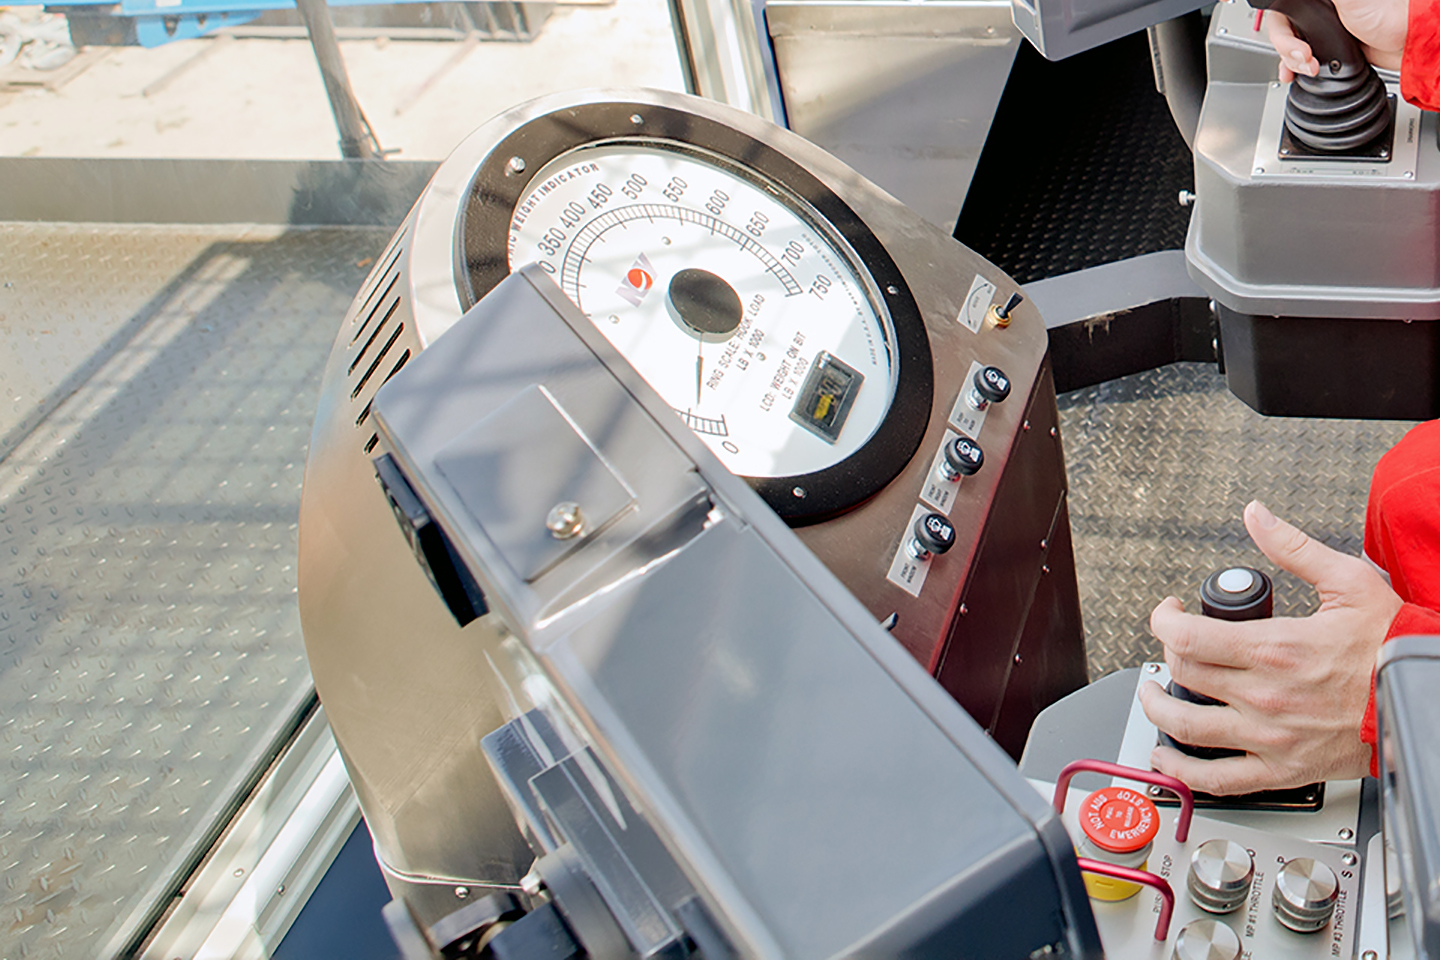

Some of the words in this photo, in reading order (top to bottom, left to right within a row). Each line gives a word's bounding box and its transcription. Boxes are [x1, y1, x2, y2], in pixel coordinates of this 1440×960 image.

[510, 194, 541, 232] WEIGHT
[538, 163, 599, 196] INDICATOR
[587, 183, 613, 210] 450
[621, 173, 648, 200] 500
[662, 176, 688, 203] 550
[559, 201, 586, 229] 400
[705, 189, 730, 216] 600
[745, 211, 770, 238] 650
[537, 227, 567, 256] 350
[781, 240, 805, 267] 700
[615, 252, 658, 308] NOV
[808, 274, 832, 301] 750
[736, 316, 754, 340] HOOK
[747, 293, 766, 317] LOAD
[736, 358, 749, 371] LB
[743, 347, 753, 358] X
[749, 328, 765, 349] 1000
[786, 344, 800, 360] ON
[792, 331, 807, 347] BIT
[770, 359, 792, 391] WEIGHT
[782, 387, 795, 400] LB
[789, 375, 799, 387] X
[721, 440, 739, 455] 0
[1090, 793, 1108, 812] AUS
[1116, 790, 1144, 807] STOP
[1088, 812, 1105, 830] NOT
[1109, 806, 1152, 839] EMERGENCY
[1160, 854, 1173, 878] STOP
[1249, 872, 1265, 913] THROTTLE
[1248, 914, 1257, 924] #1
[1334, 890, 1348, 930] THROTTLE
[1245, 924, 1255, 937] MP
[1331, 943, 1341, 957] MP
